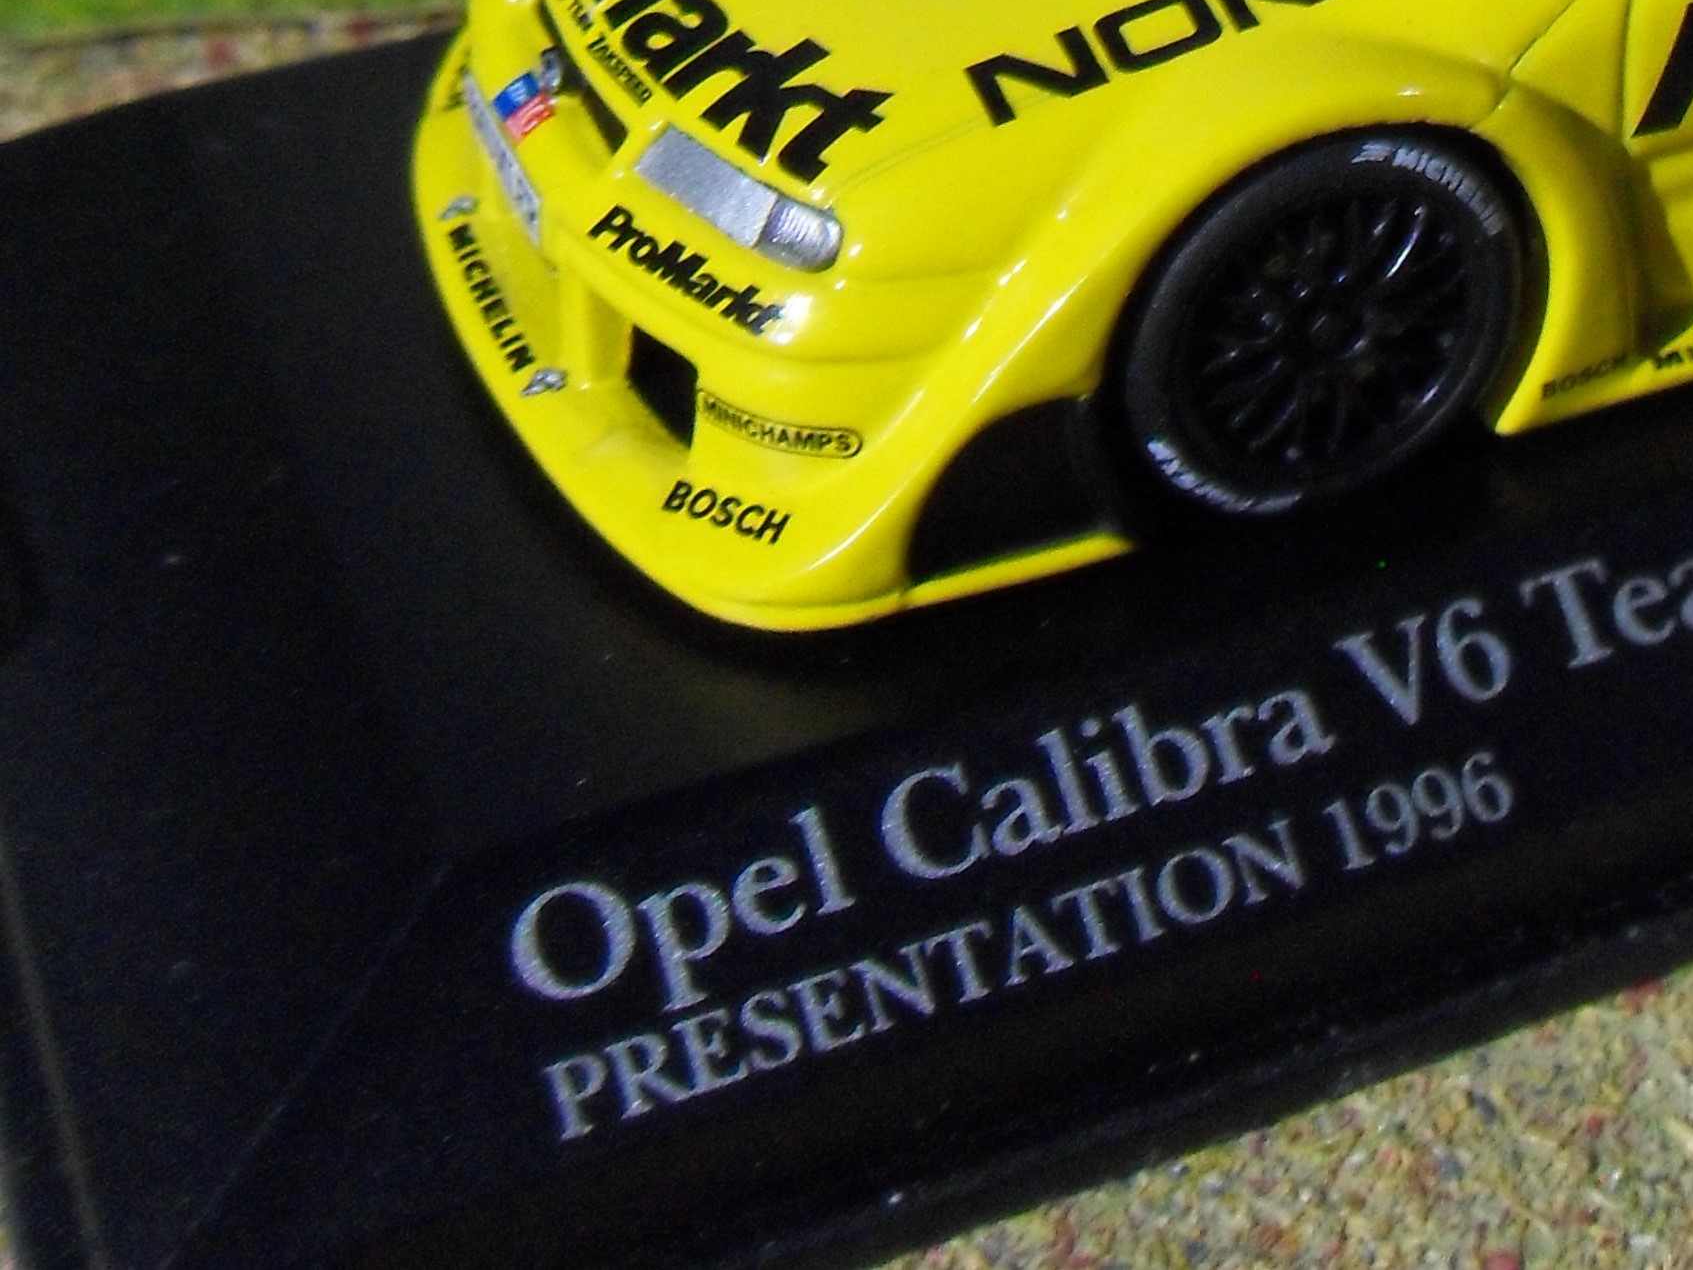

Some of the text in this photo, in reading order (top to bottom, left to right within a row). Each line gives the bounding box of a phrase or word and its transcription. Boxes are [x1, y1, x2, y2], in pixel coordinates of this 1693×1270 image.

[447, 224, 538, 373] MICHELIN
[586, 205, 782, 338] ProMarkt
[701, 394, 856, 454] MINICHAMPS
[660, 480, 791, 546] BOSCH
[510, 808, 857, 1014] Opel
[882, 682, 1338, 882] Calibra
[1334, 592, 1514, 728] V6
[544, 748, 1516, 1142] PRESENTATION 1996
